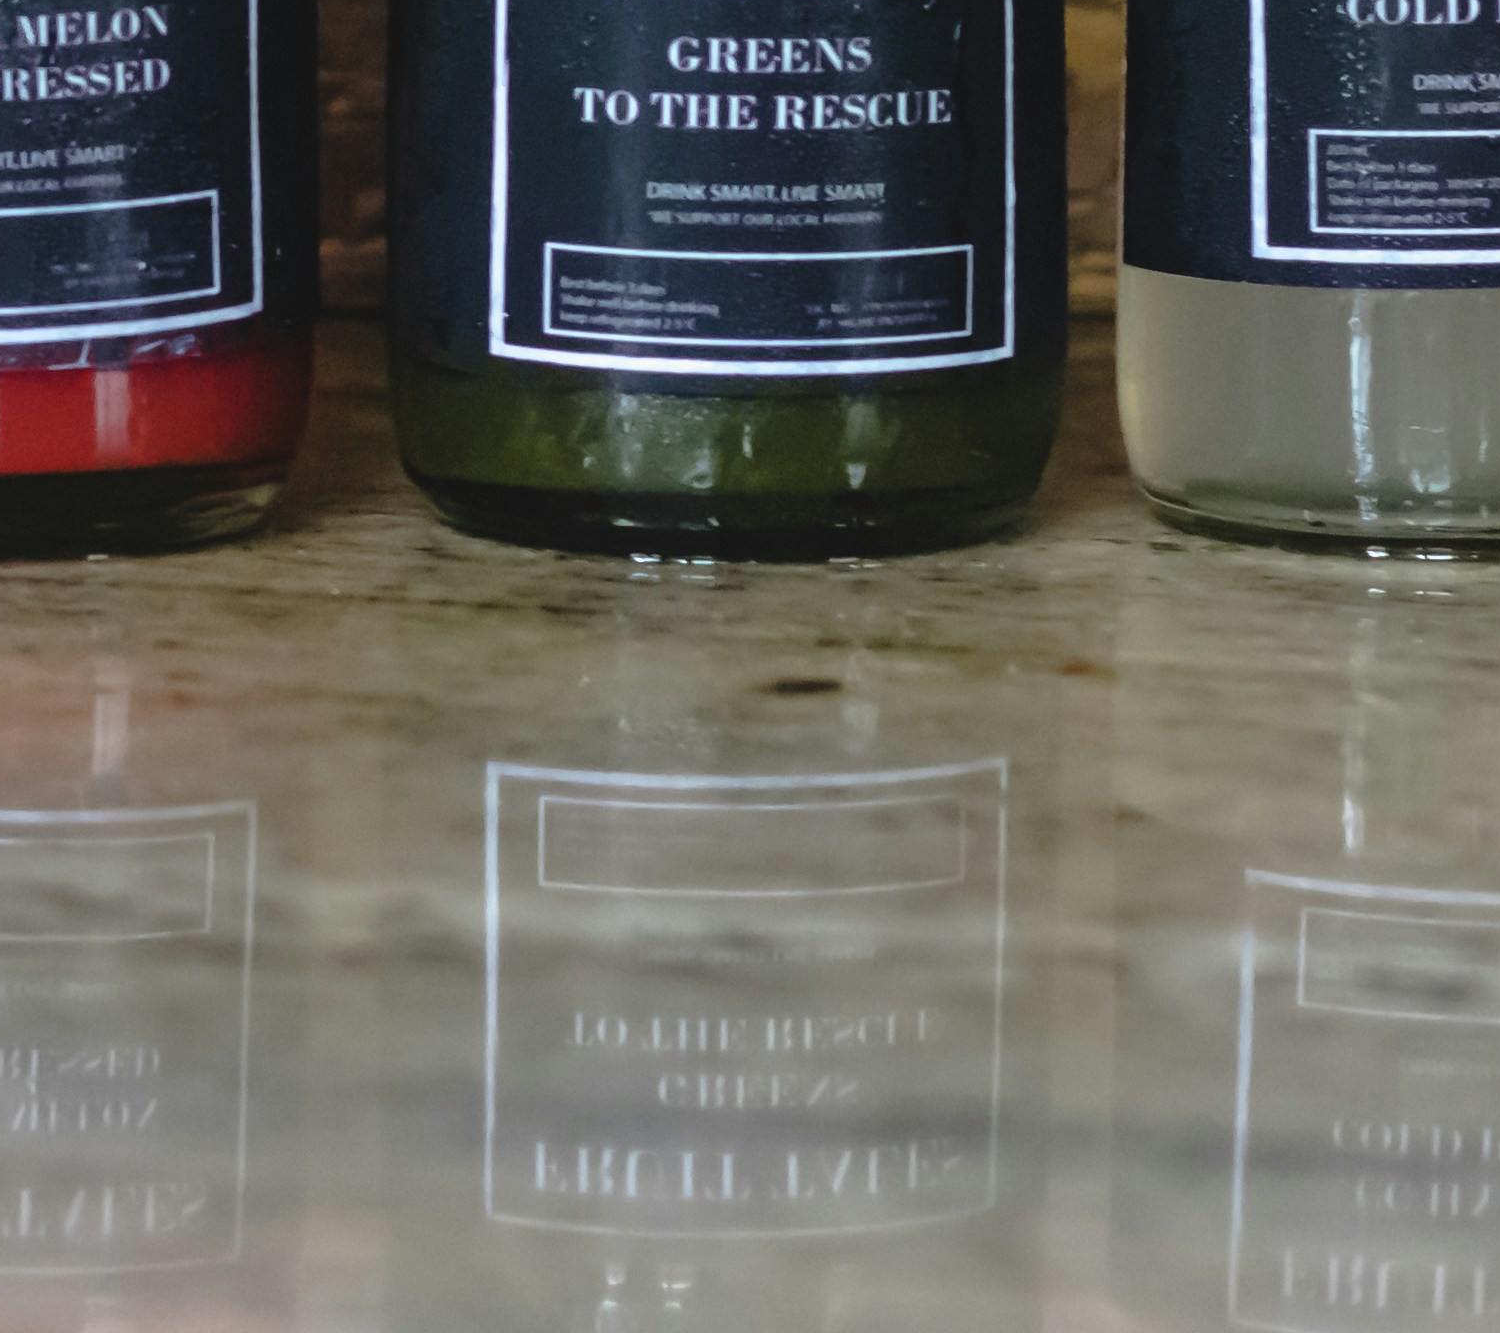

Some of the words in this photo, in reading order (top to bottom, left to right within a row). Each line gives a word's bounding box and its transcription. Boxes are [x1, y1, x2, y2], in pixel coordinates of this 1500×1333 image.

[16, 5, 168, 49] MELON
[668, 36, 872, 73] GREENS
[574, 87, 640, 125] TO
[650, 92, 759, 130] THE
[773, 90, 951, 130] RESCUE
